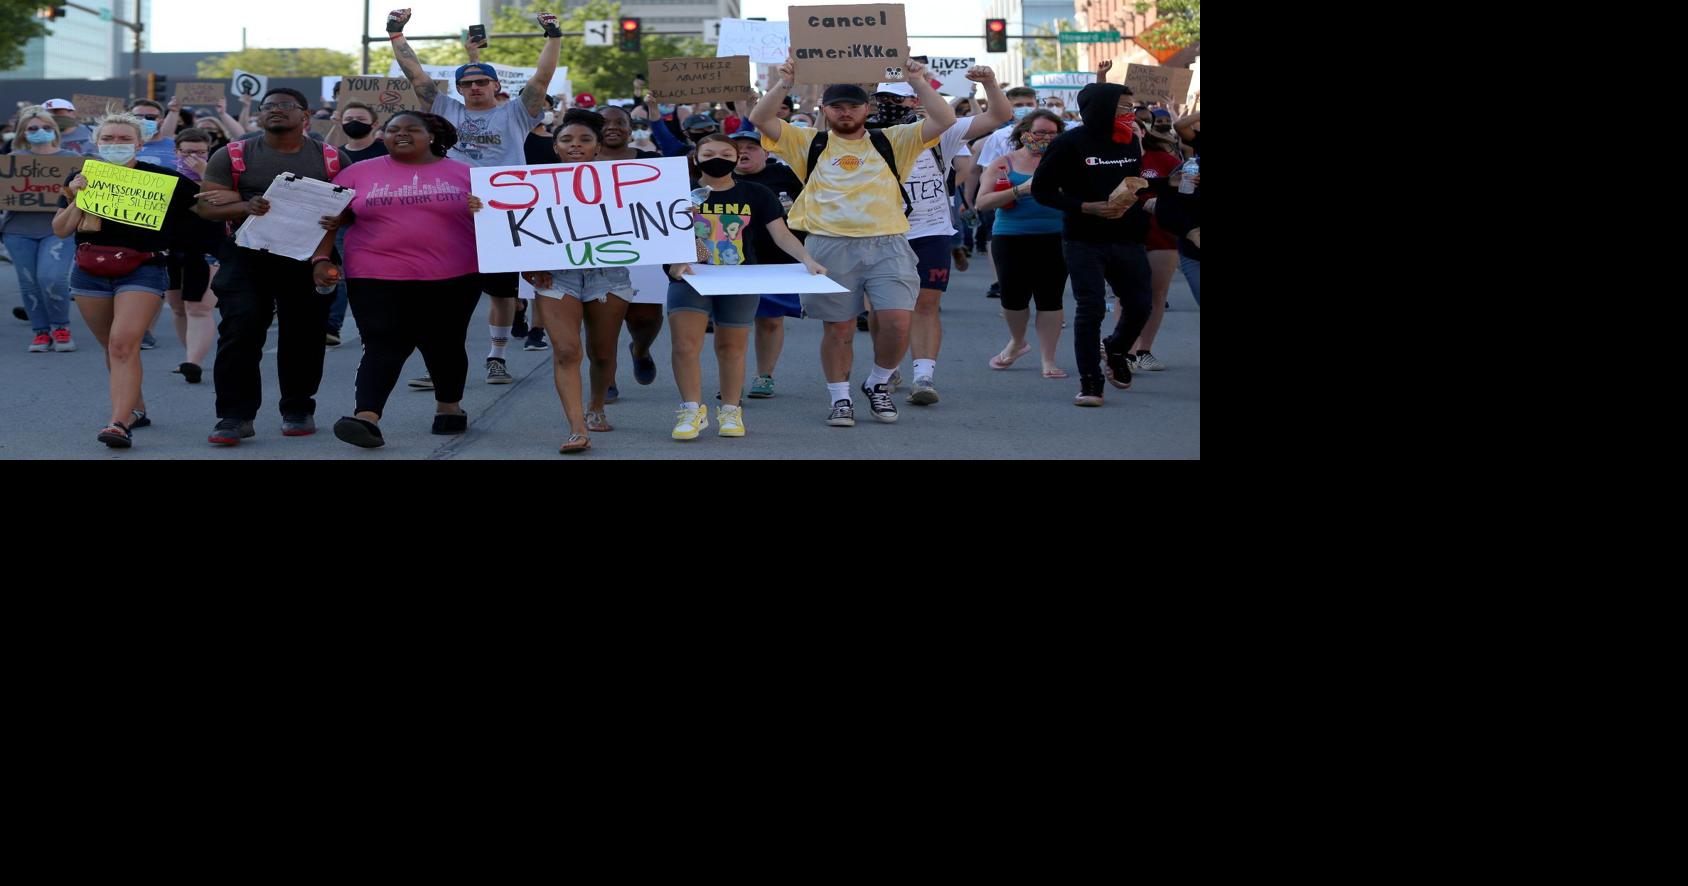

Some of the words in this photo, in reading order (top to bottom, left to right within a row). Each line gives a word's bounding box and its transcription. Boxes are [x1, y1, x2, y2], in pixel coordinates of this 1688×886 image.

[808, 11, 887, 27] cancel
[796, 44, 898, 59] ameriKKKa
[662, 61, 687, 73] SAY
[347, 78, 380, 91] YOUR
[652, 89, 687, 98] BLACK
[690, 86, 721, 95] LIVES
[0, 155, 61, 178] Justice
[1085, 156, 1137, 167] Champion
[11, 176, 63, 193] Jame
[488, 162, 661, 210] STOP
[3, 193, 60, 207] #BL
[84, 190, 125, 204] WHITE
[128, 197, 166, 213] SILENCE
[365, 196, 393, 208] NEW
[400, 194, 432, 206] YORK
[436, 192, 462, 202] CITY
[83, 198, 160, 226] VIOLENCE
[507, 199, 694, 247] KILLING
[566, 240, 640, 266] US
[929, 268, 949, 282] M
